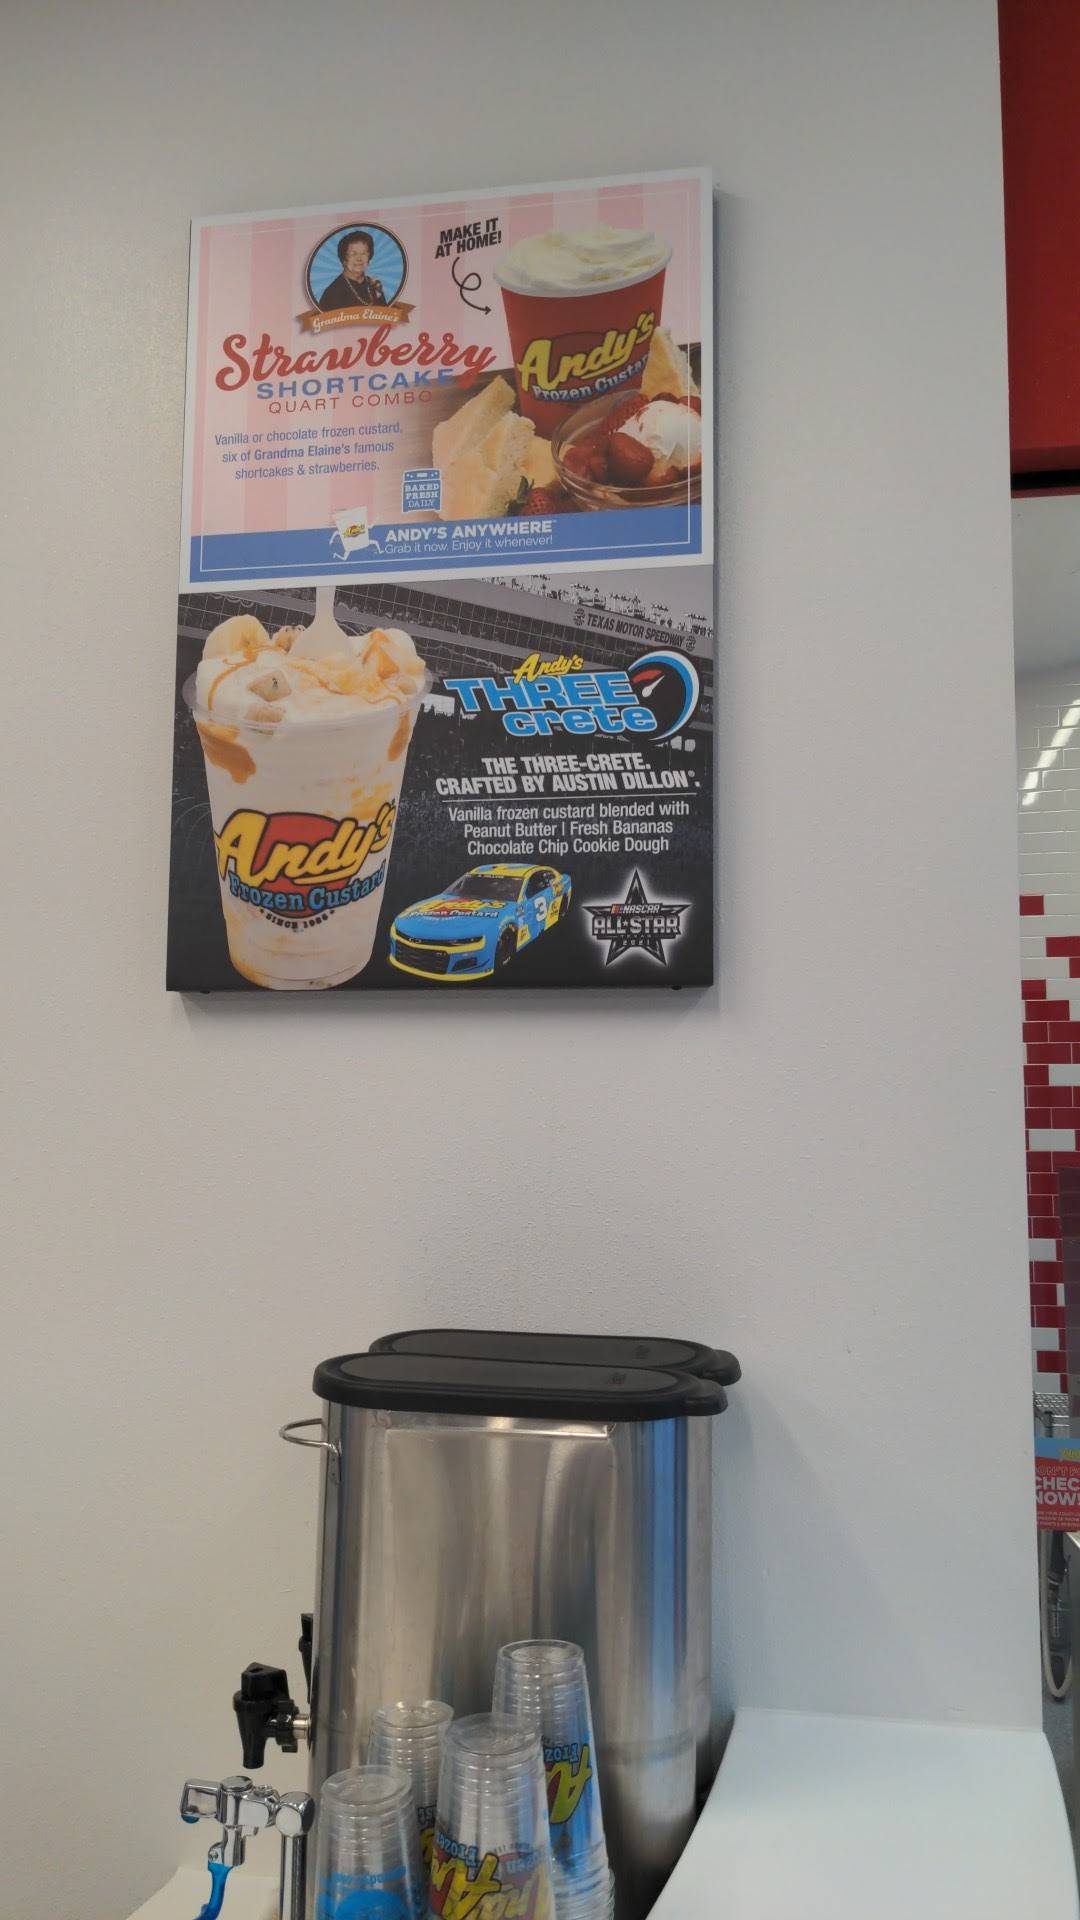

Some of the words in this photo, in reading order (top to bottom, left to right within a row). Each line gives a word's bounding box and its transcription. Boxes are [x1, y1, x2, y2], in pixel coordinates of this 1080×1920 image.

[440, 222, 481, 245] MAKE
[485, 217, 499, 234] IT
[435, 243, 451, 259] AT
[457, 231, 502, 254] HOME!
[312, 311, 360, 334] Grandma
[215, 323, 497, 391] Strawberry
[516, 311, 655, 391] Andy's
[257, 368, 454, 400] SHORTCAKE
[532, 384, 593, 401] Frozen
[594, 354, 649, 392] Custar
[269, 397, 340, 414] QUART
[352, 390, 432, 408] COMBO
[215, 432, 248, 446] Vanilla
[252, 434, 263, 444] or
[267, 430, 318, 443] chocolate
[321, 427, 355, 439] frozen
[222, 450, 237, 463] six
[240, 449, 252, 462] of
[254, 447, 304, 461] Grandma
[308, 443, 350, 457] Elaine's
[353, 441, 394, 454] famous
[235, 466, 293, 480] shortcakes
[297, 464, 305, 475] &
[308, 460, 380, 475] strawberries.
[404, 483, 440, 492] BAKED
[405, 491, 439, 500] FRESH
[407, 499, 435, 508] DAILY
[384, 541, 411, 554] Grab
[414, 542, 421, 553] it
[424, 543, 449, 552] now.
[452, 540, 482, 554] Enjoy
[485, 538, 492, 550] it
[495, 533, 553, 549] whenever!
[385, 526, 447, 543] ANDY'S
[588, 614, 615, 631] TEXAS
[615, 622, 645, 639] MOTOR
[644, 627, 685, 648] SPEEDWAY
[513, 652, 584, 684] Andy's
[443, 671, 640, 712] THREE
[503, 705, 657, 736] crete
[482, 757, 518, 776] THE
[520, 753, 651, 775] THREE-CRETE.
[436, 777, 517, 796] CRAFTED
[523, 775, 545, 793] BY
[553, 773, 617, 792] AUSTIN
[449, 806, 492, 821] Vanilla
[497, 805, 538, 820] frozen
[543, 803, 595, 820] custard
[600, 802, 654, 817] blended
[659, 800, 689, 816] with
[464, 823, 510, 838] Peanut
[515, 822, 557, 837] Butter
[570, 820, 608, 836] Fresh
[613, 819, 673, 834] Bananas
[214, 798, 396, 887] Andy's
[467, 839, 533, 856] Chocolate
[539, 838, 568, 856] Chip
[573, 837, 620, 853] Cookie
[625, 836, 669, 854] Dough
[228, 869, 304, 912] Frozen
[308, 858, 386, 912] Custard
[534, 896, 547, 922] 3
[623, 904, 661, 914] NASCAR
